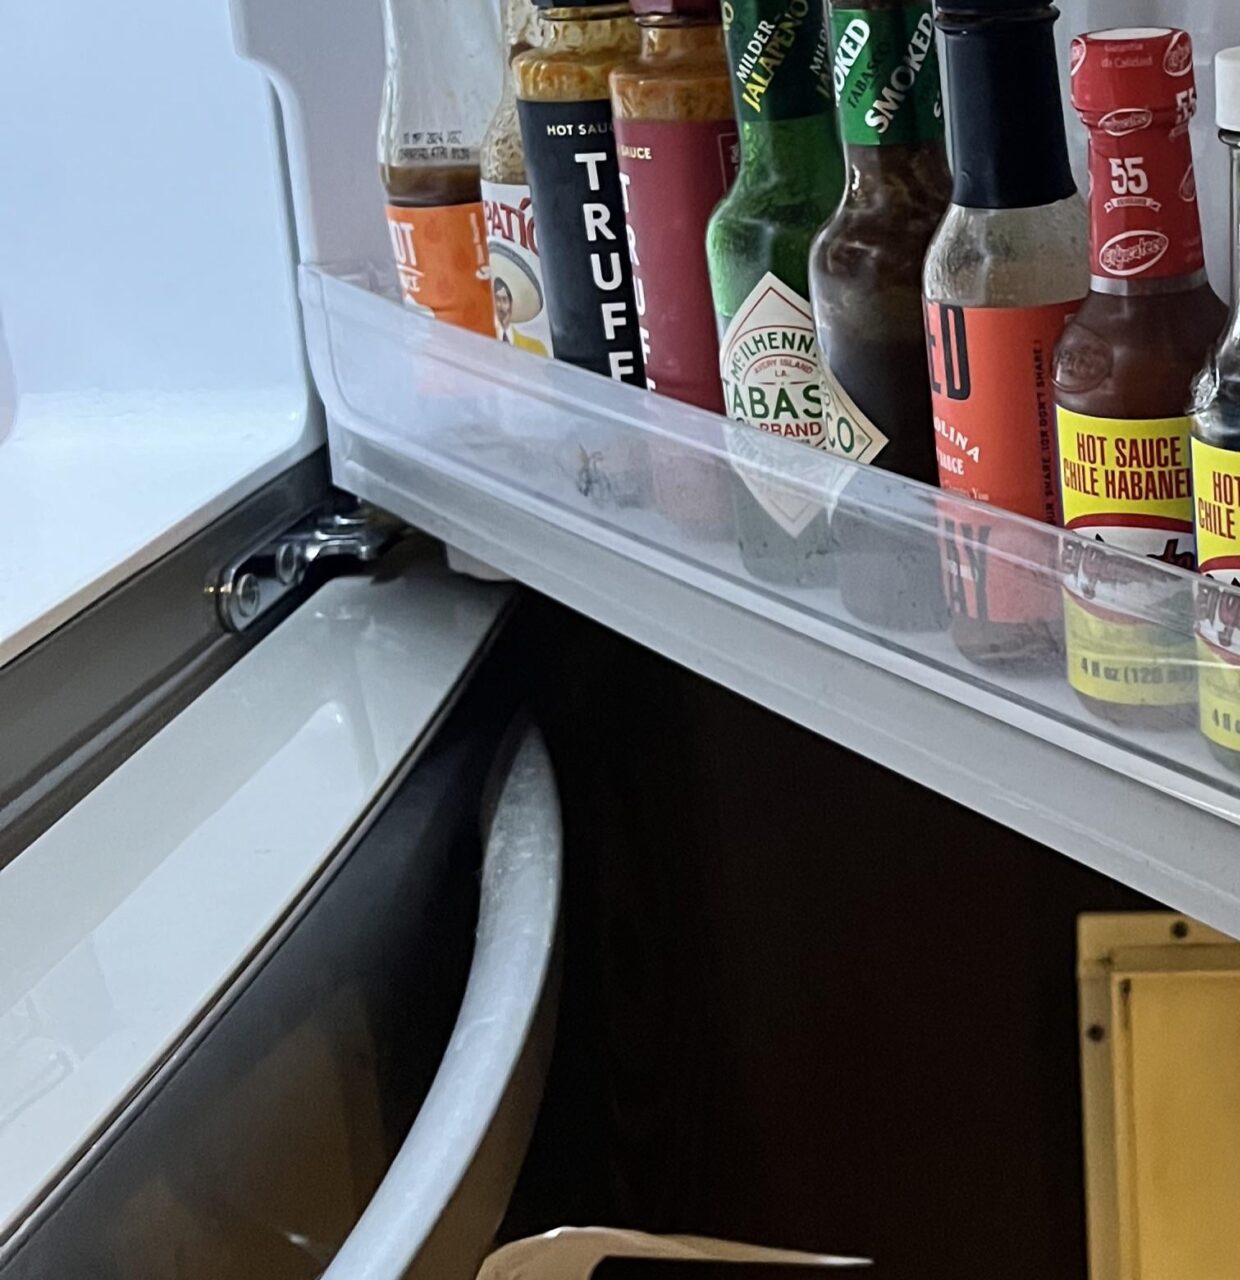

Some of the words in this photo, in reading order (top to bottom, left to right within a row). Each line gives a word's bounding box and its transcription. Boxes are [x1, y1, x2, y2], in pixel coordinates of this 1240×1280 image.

[736, 20, 776, 84] MILDER
[865, 12, 935, 134] SMOKED
[547, 124, 574, 137] HOT
[1108, 157, 1149, 195] 55
[780, 358, 813, 375] ISLAND
[1076, 432, 1108, 468] HOT
[1115, 436, 1182, 468] SAUCE
[1063, 457, 1100, 499] CHILE
[1198, 497, 1236, 540] CHILE
